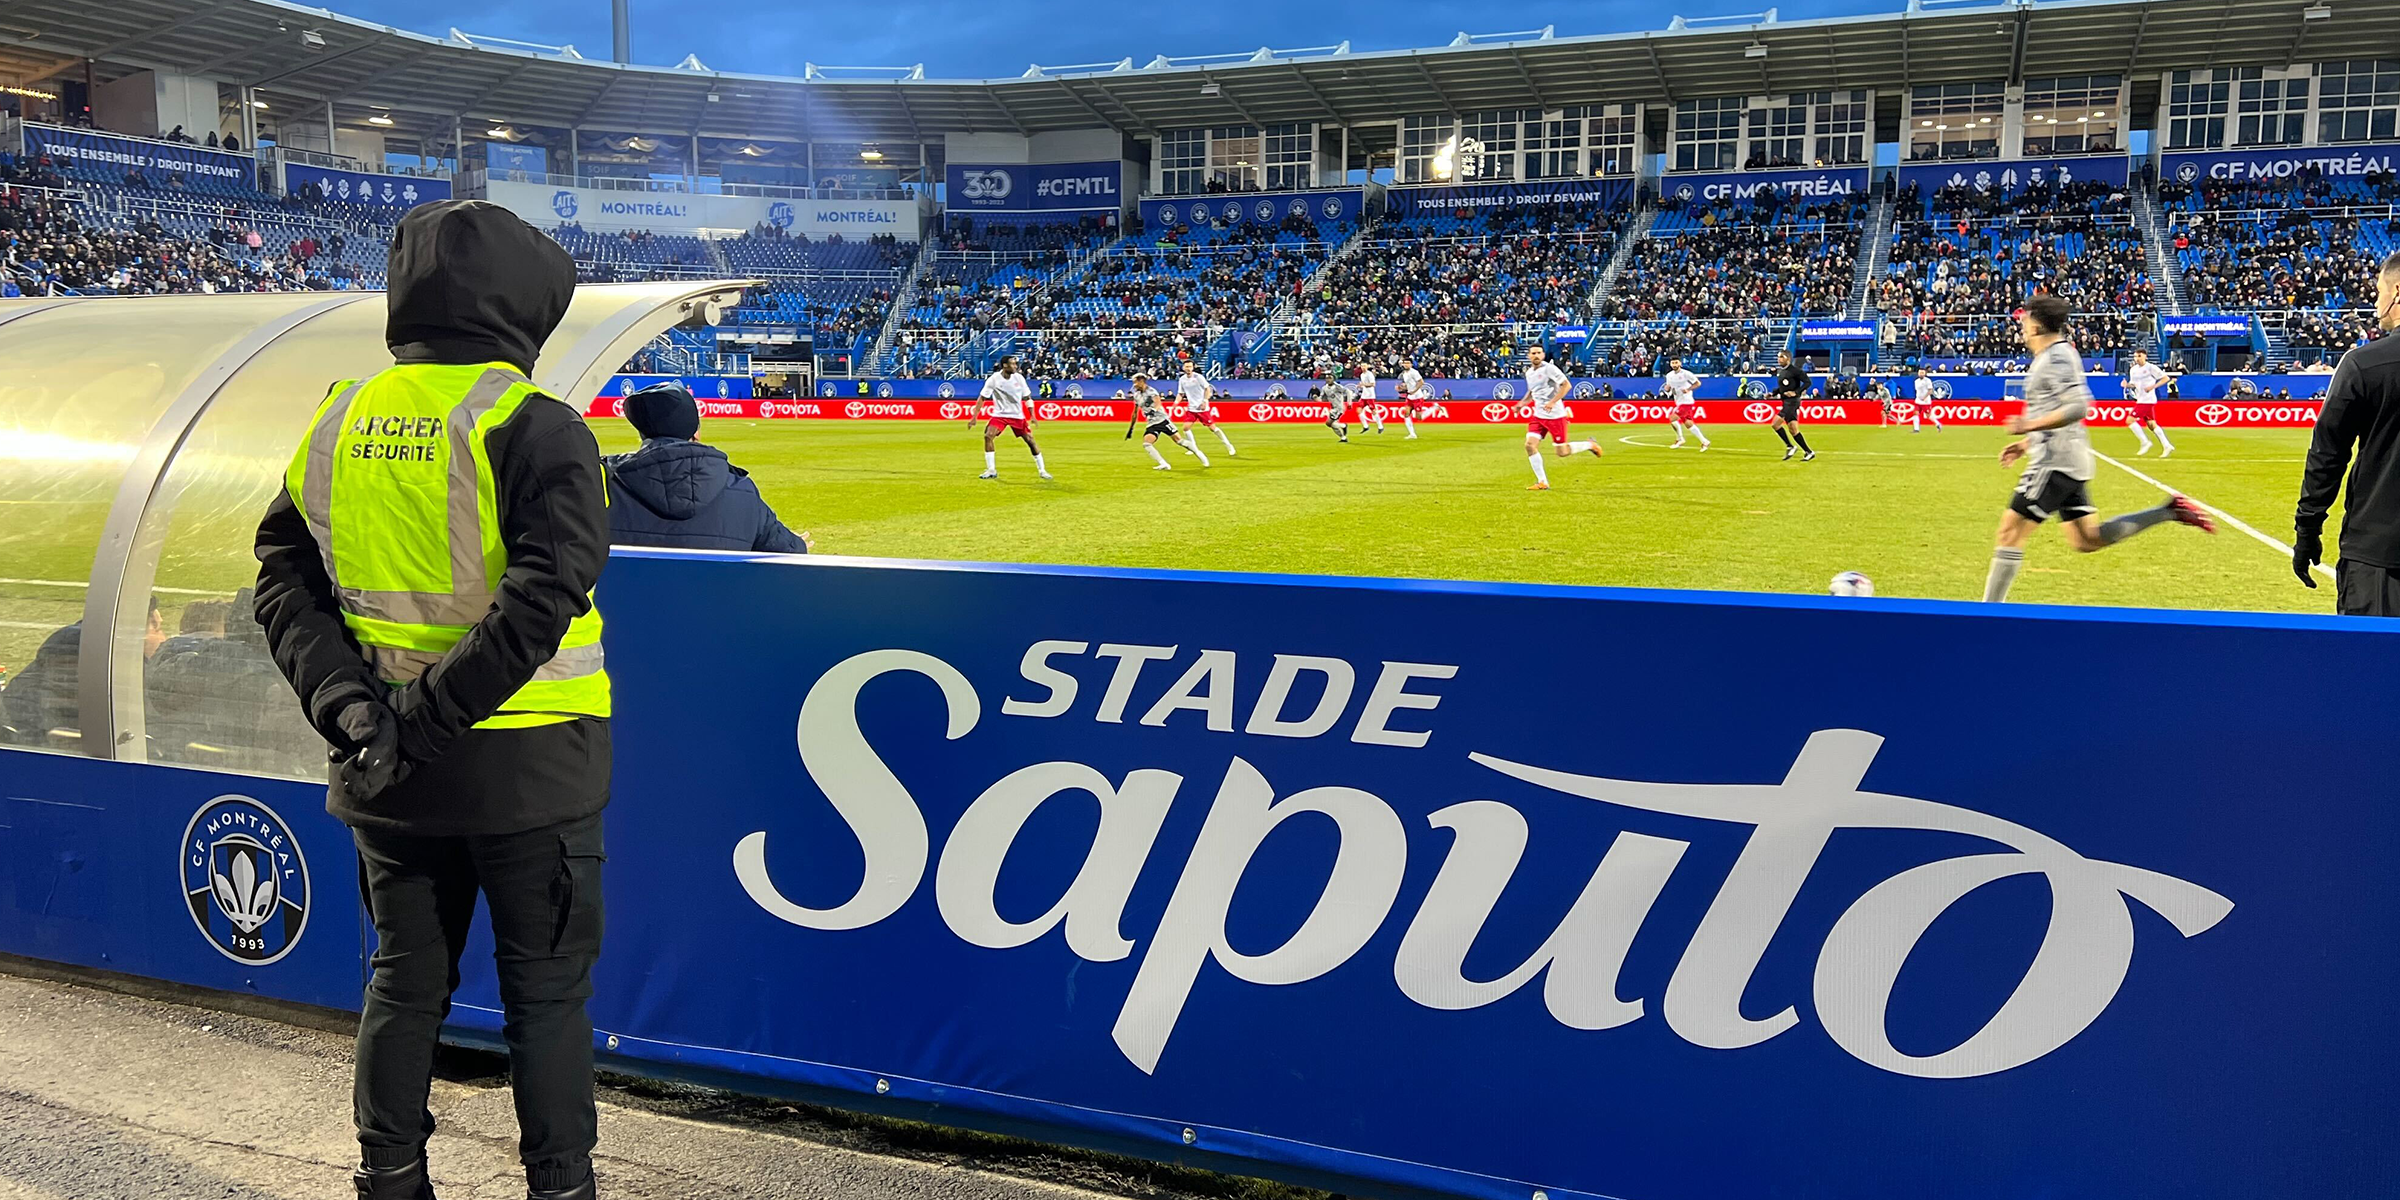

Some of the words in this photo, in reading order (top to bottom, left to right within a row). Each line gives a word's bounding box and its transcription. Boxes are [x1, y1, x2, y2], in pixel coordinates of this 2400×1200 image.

[44, 143, 78, 158] TOUS
[80, 150, 146, 166] ENSEMBLE
[157, 157, 193, 173] DROIT
[195, 163, 241, 178] DEVANT
[587, 164, 610, 174] SOIF
[2210, 161, 2245, 180] CF
[836, 173, 857, 182] SOIF
[1036, 176, 1116, 197] #CFMTL
[1703, 183, 1733, 200] CF
[1417, 199, 1446, 209] TOUS
[1447, 196, 1505, 207] ENSEMBLE
[1516, 193, 1550, 204] DROIT
[1554, 191, 1601, 203] DEVANT
[2163, 323, 2193, 332] ALLEZ
[707, 403, 743, 415] TOYOTA
[775, 404, 821, 415] TOYOTA
[866, 404, 915, 416] TOYOTA
[1062, 405, 1114, 417] TOYOTA
[1275, 406, 1331, 418] TOYOTA
[2234, 406, 2318, 422] TOYOTA
[350, 440, 435, 462] SÉCURITÉ
[1001, 639, 1460, 749] STADE
[192, 838, 206, 867] CF
[206, 811, 295, 880] MONTRÉAL
[733, 647, 2235, 1079] Saputo
[231, 934, 265, 950] 1993
